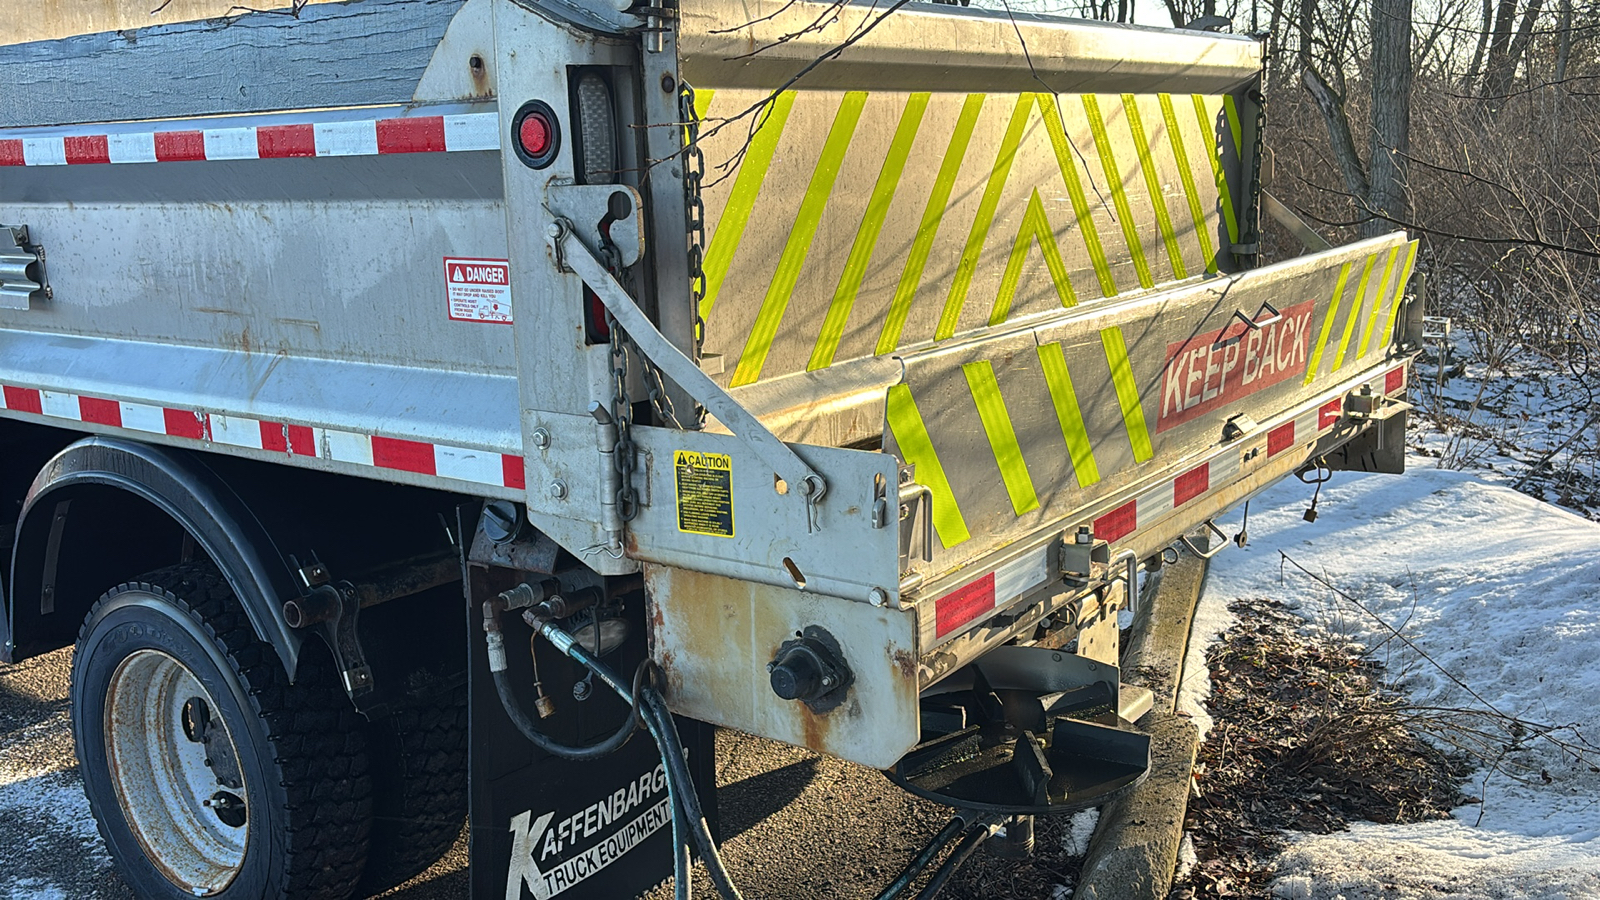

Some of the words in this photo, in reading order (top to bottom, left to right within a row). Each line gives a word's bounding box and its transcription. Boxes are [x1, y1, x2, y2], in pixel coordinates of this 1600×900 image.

[466, 266, 505, 283] DANGER
[1162, 340, 1241, 419] KEEP
[1242, 311, 1311, 386] BACK
[688, 455, 729, 468] CAUTION
[543, 851, 599, 895] TRUCK
[598, 800, 669, 866] EQUIPMENT
